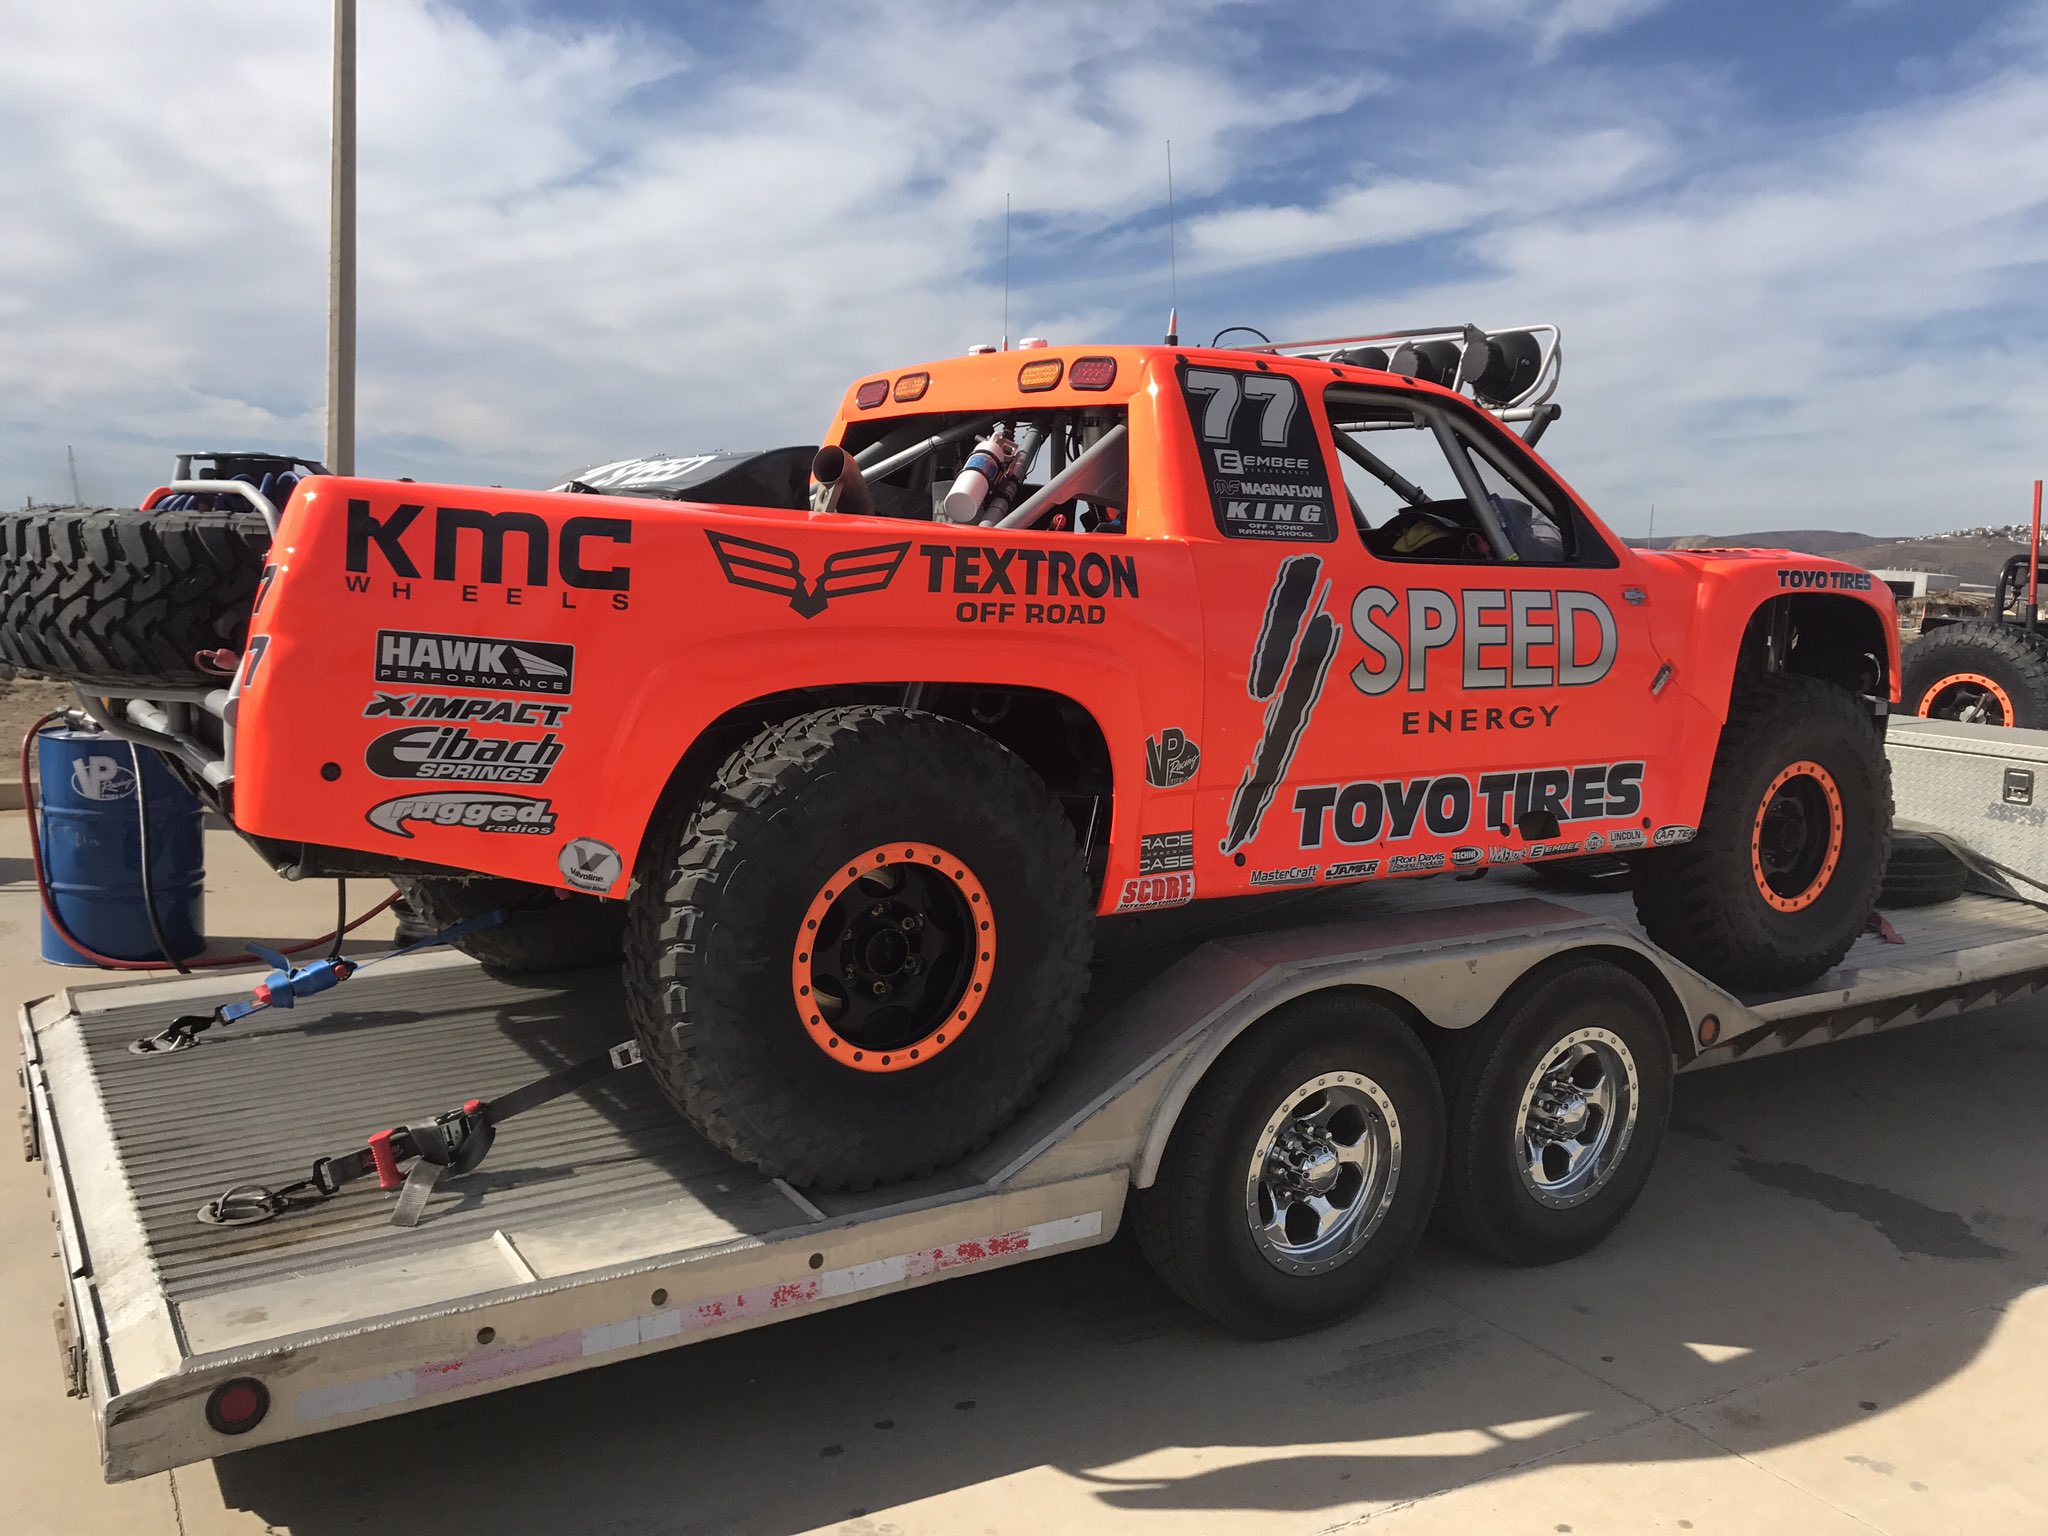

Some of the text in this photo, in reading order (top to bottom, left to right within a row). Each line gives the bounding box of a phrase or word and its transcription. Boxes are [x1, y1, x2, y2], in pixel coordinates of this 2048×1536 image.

[1185, 368, 1298, 447] 77
[1243, 455, 1309, 469] EMBEE
[1241, 482, 1322, 498] MAGNAFLOW
[1227, 501, 1321, 522] KING
[1238, 528, 1275, 536] RACING
[920, 544, 1139, 599] TEXTRON
[1777, 569, 1872, 592] TOYO TIRES
[345, 576, 630, 611] WHEELS
[956, 602, 1106, 625] OFF ROAD
[1349, 585, 1618, 696] SPEED
[381, 635, 509, 674] HAWK
[380, 669, 563, 690] PERFORMANCE
[1402, 705, 1560, 735] ENERGY
[366, 726, 565, 775] Eibach
[1145, 727, 1186, 788] VP
[72, 755, 118, 800] VP
[415, 763, 539, 782] SPRINGS
[1293, 761, 1647, 850] TOYO TIRES
[484, 823, 552, 835] radios
[1610, 830, 1641, 841] LINCOLN
[1141, 834, 1193, 850] RACE
[1395, 852, 1445, 864] Ron Davis
[570, 867, 604, 882] Valvoline
[1250, 865, 1317, 882] MasterCraft
[1325, 862, 1378, 876] JAMAR
[1122, 875, 1191, 904] SCORE
[1119, 898, 1188, 909] INTERNATIONAL
